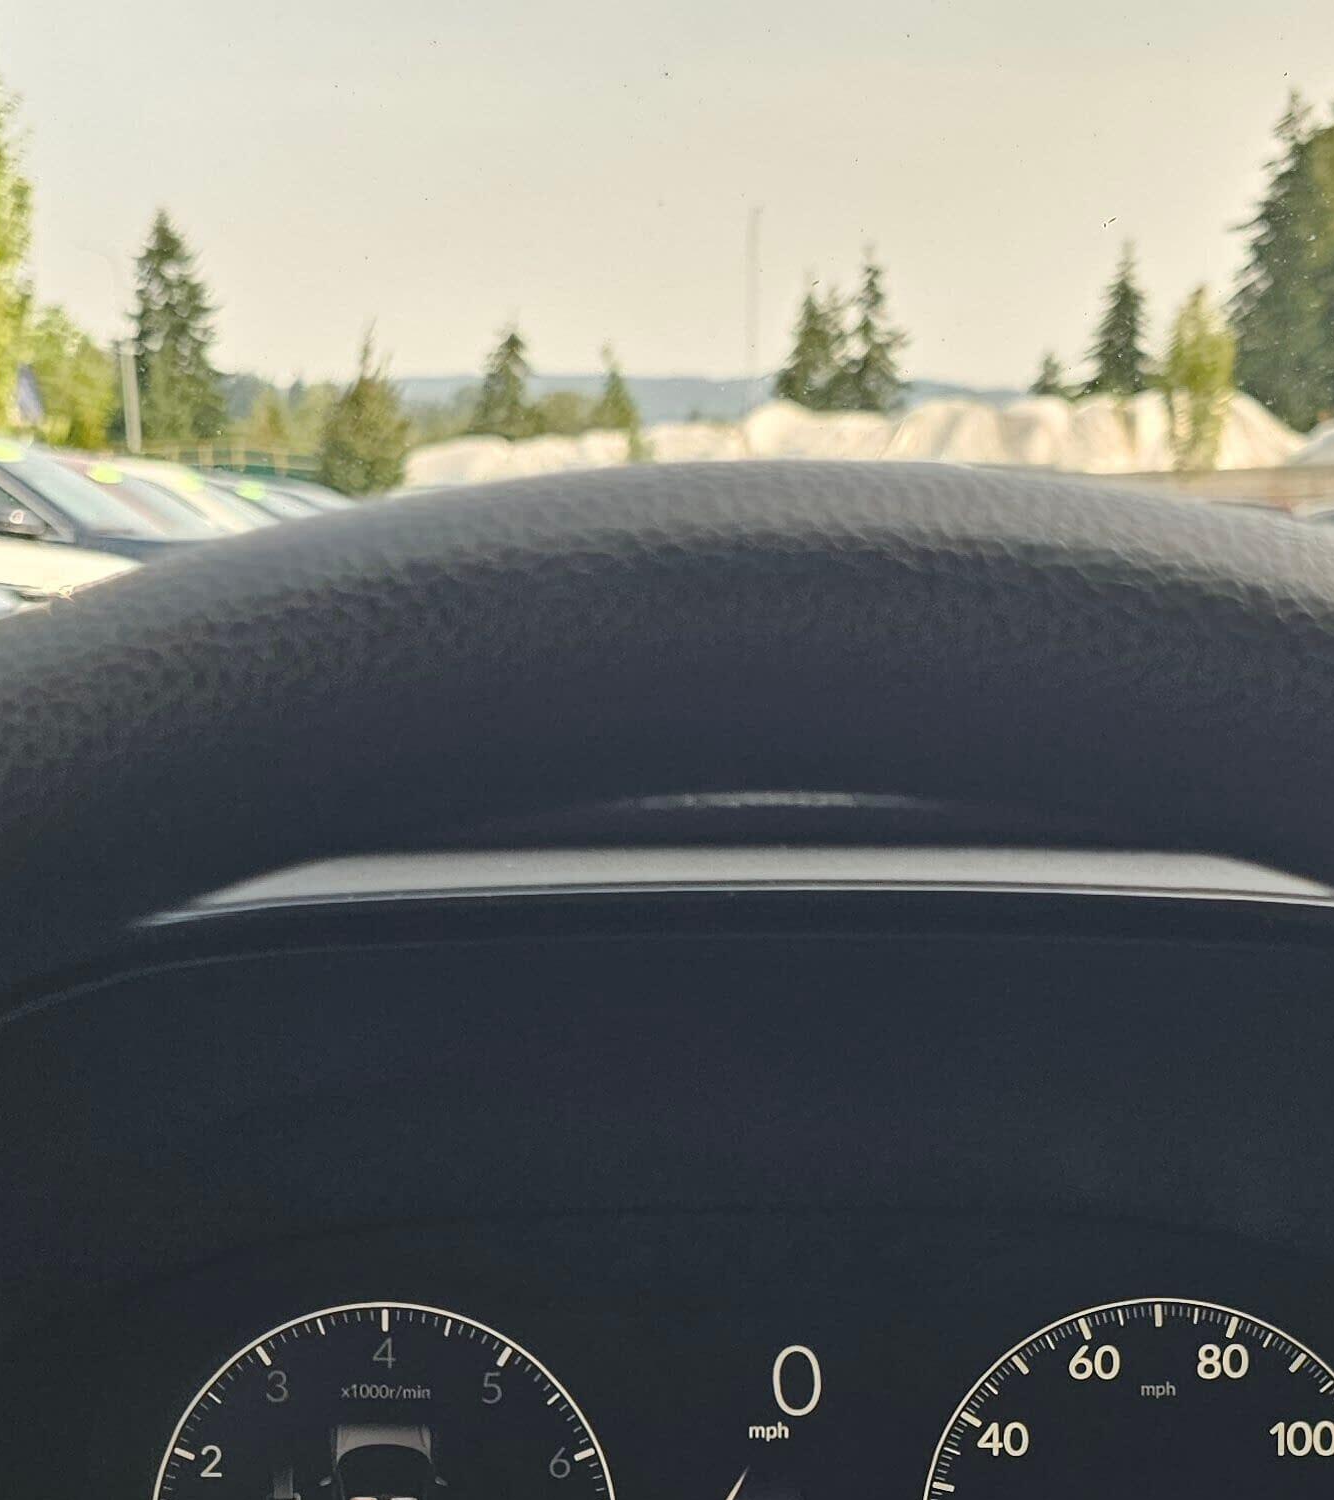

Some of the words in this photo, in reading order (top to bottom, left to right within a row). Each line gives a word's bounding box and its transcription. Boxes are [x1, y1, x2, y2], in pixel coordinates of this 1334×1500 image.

[373, 1338, 396, 1368] 4
[1069, 1345, 1120, 1379] 60
[1197, 1344, 1248, 1379] 80
[266, 1371, 288, 1402] 3
[340, 1382, 432, 1401] x1000r/min
[483, 1372, 502, 1404] 5
[773, 1345, 821, 1416] 0
[1141, 1382, 1176, 1398] mph
[749, 1422, 789, 1441] mph
[977, 1422, 1029, 1456] 40
[201, 1445, 222, 1477] 2
[550, 1447, 570, 1478] 6
